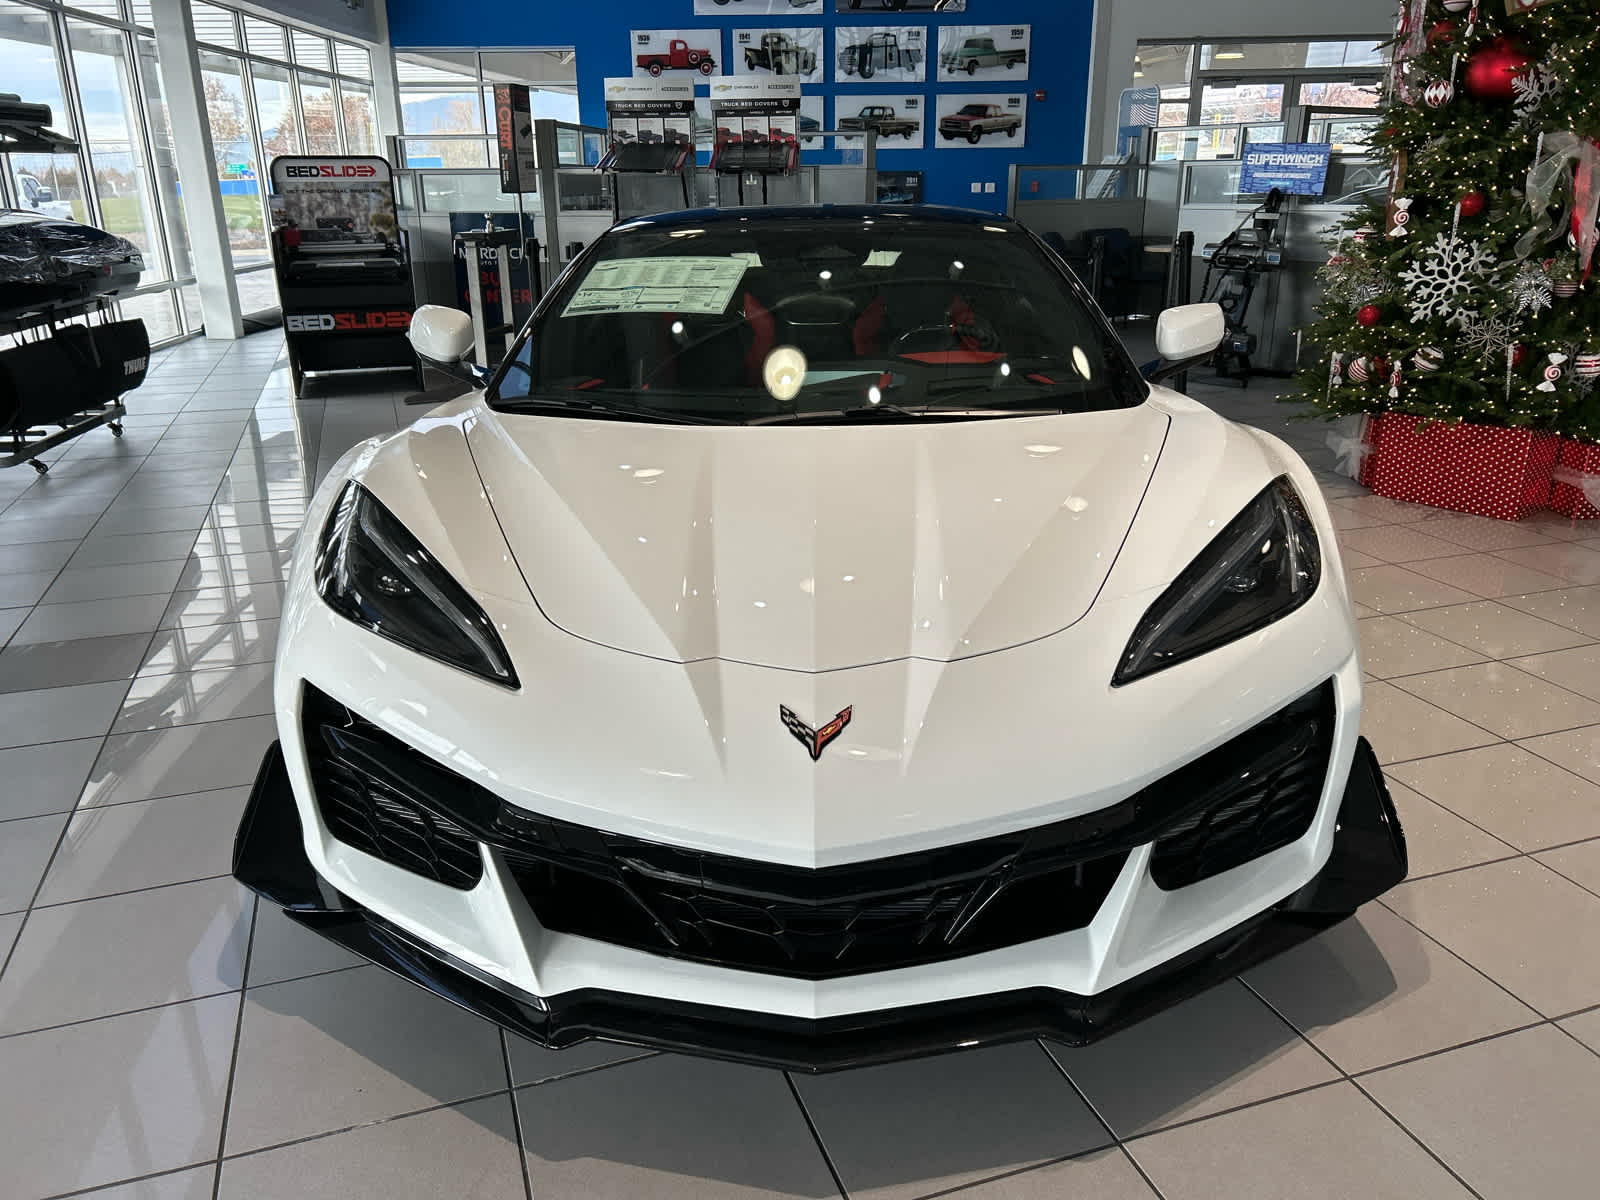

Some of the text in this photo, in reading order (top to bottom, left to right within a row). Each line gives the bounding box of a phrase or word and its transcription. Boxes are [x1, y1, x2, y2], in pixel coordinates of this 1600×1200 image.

[1247, 153, 1324, 166] SUPERWINCH
[286, 165, 377, 178] BEDSLIDE
[124, 356, 146, 376] THULE
